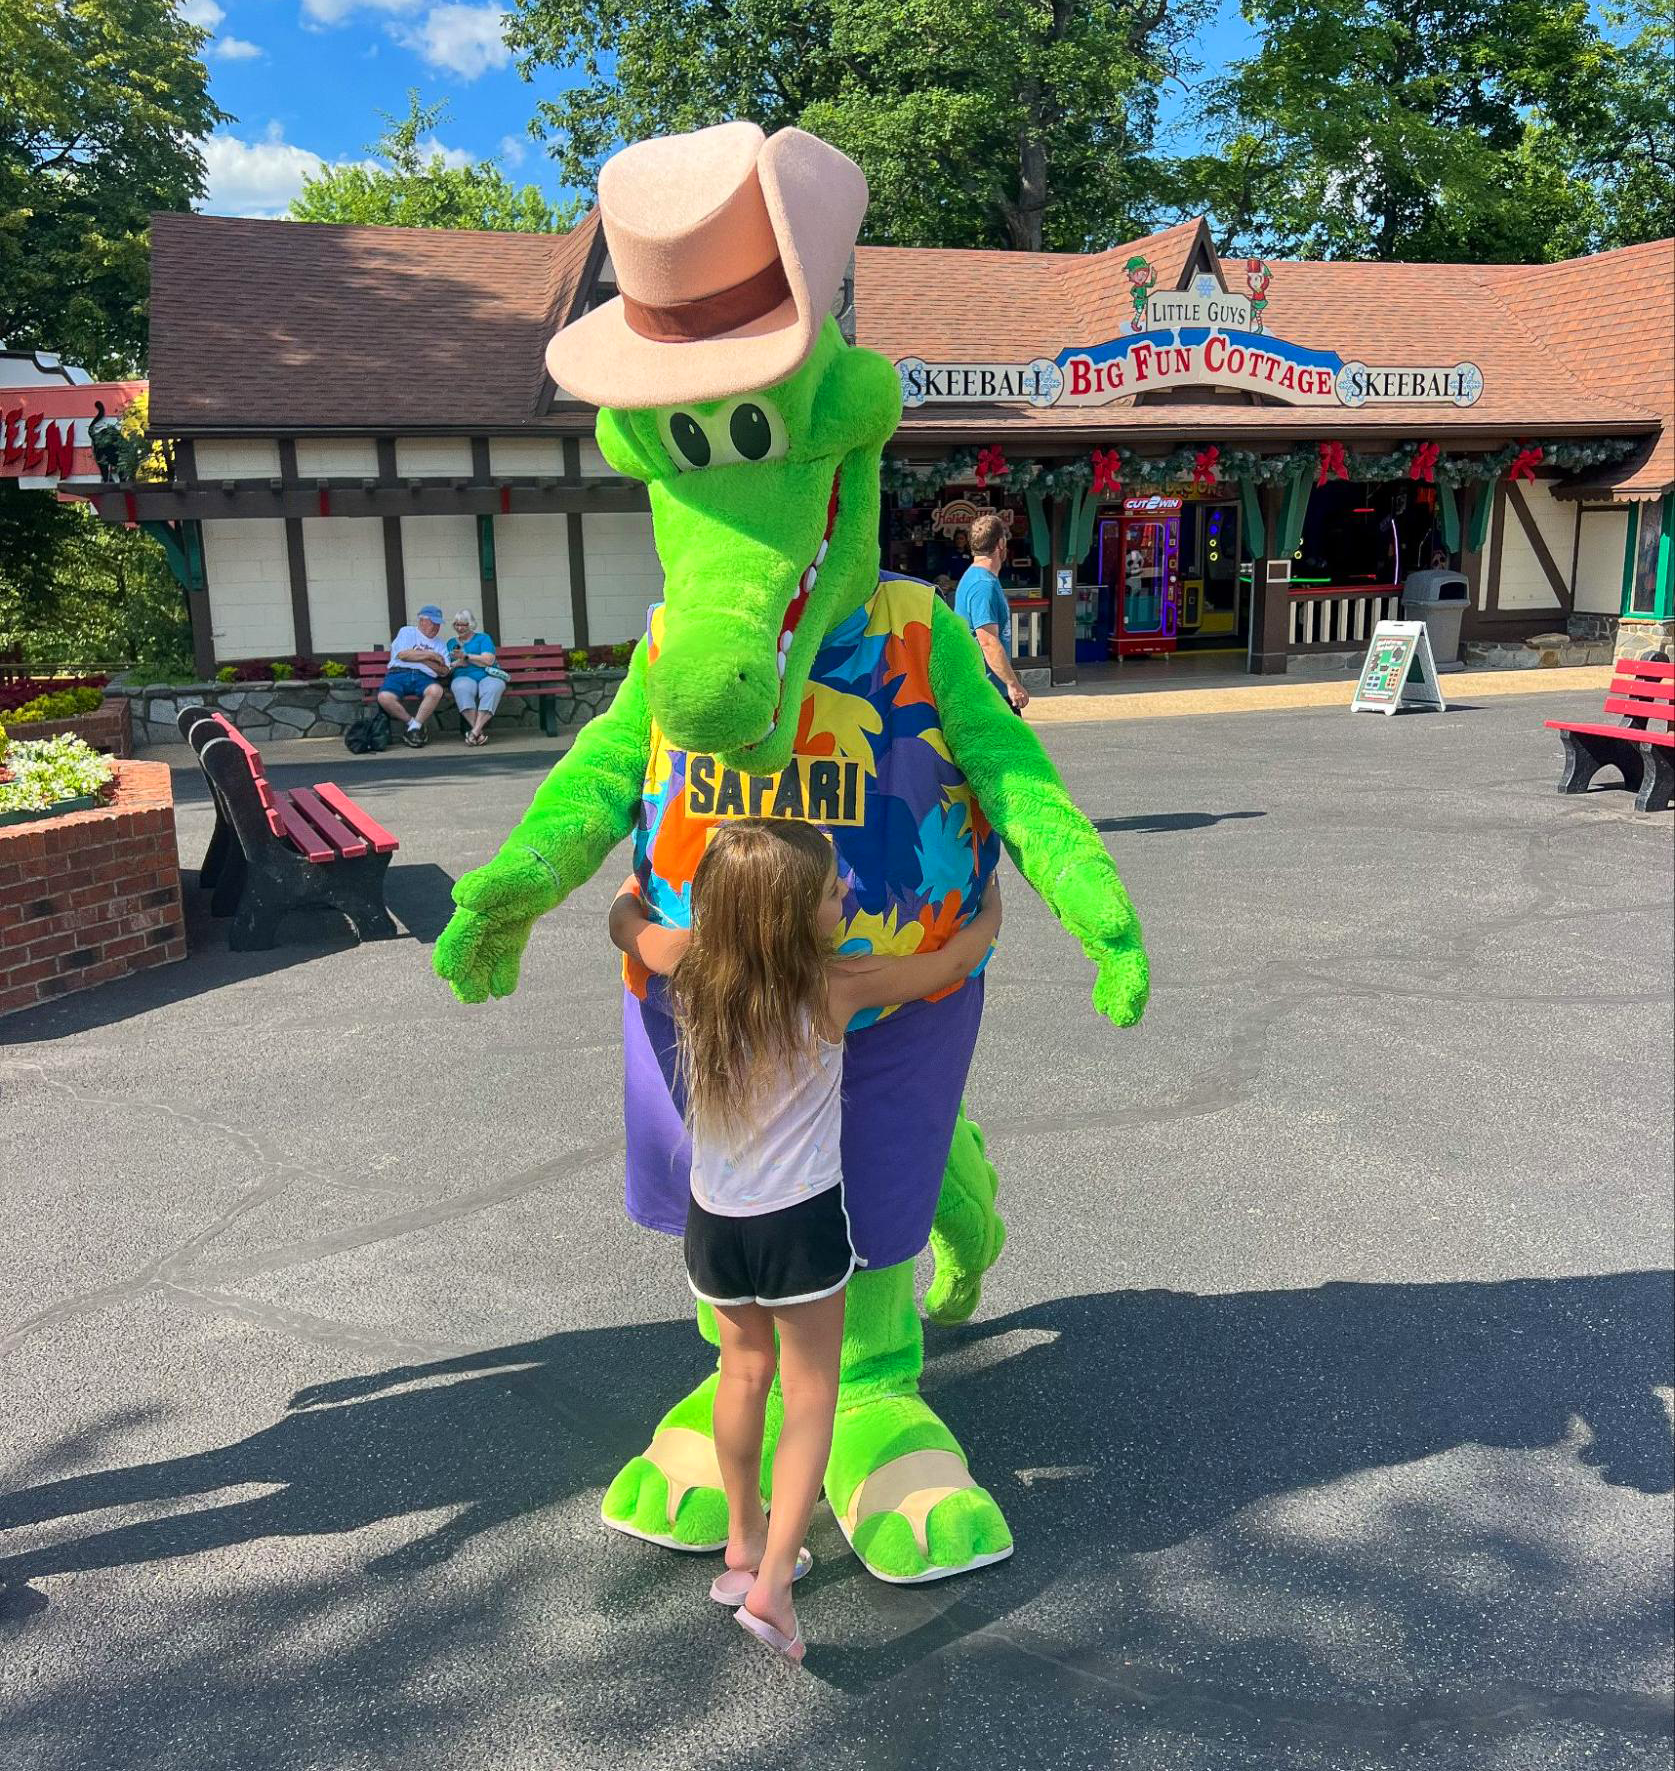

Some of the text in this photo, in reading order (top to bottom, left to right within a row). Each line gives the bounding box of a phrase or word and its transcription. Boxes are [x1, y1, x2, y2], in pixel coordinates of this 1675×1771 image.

[1152, 302, 1246, 325] LITTLE GUYS
[908, 369, 1049, 397] SKEEBALL
[1069, 336, 1332, 395] BIG FUN COTTAGE
[1351, 372, 1470, 397] SKEEBALL
[0, 407, 75, 480] EEN
[689, 756, 859, 820] SAFARI
